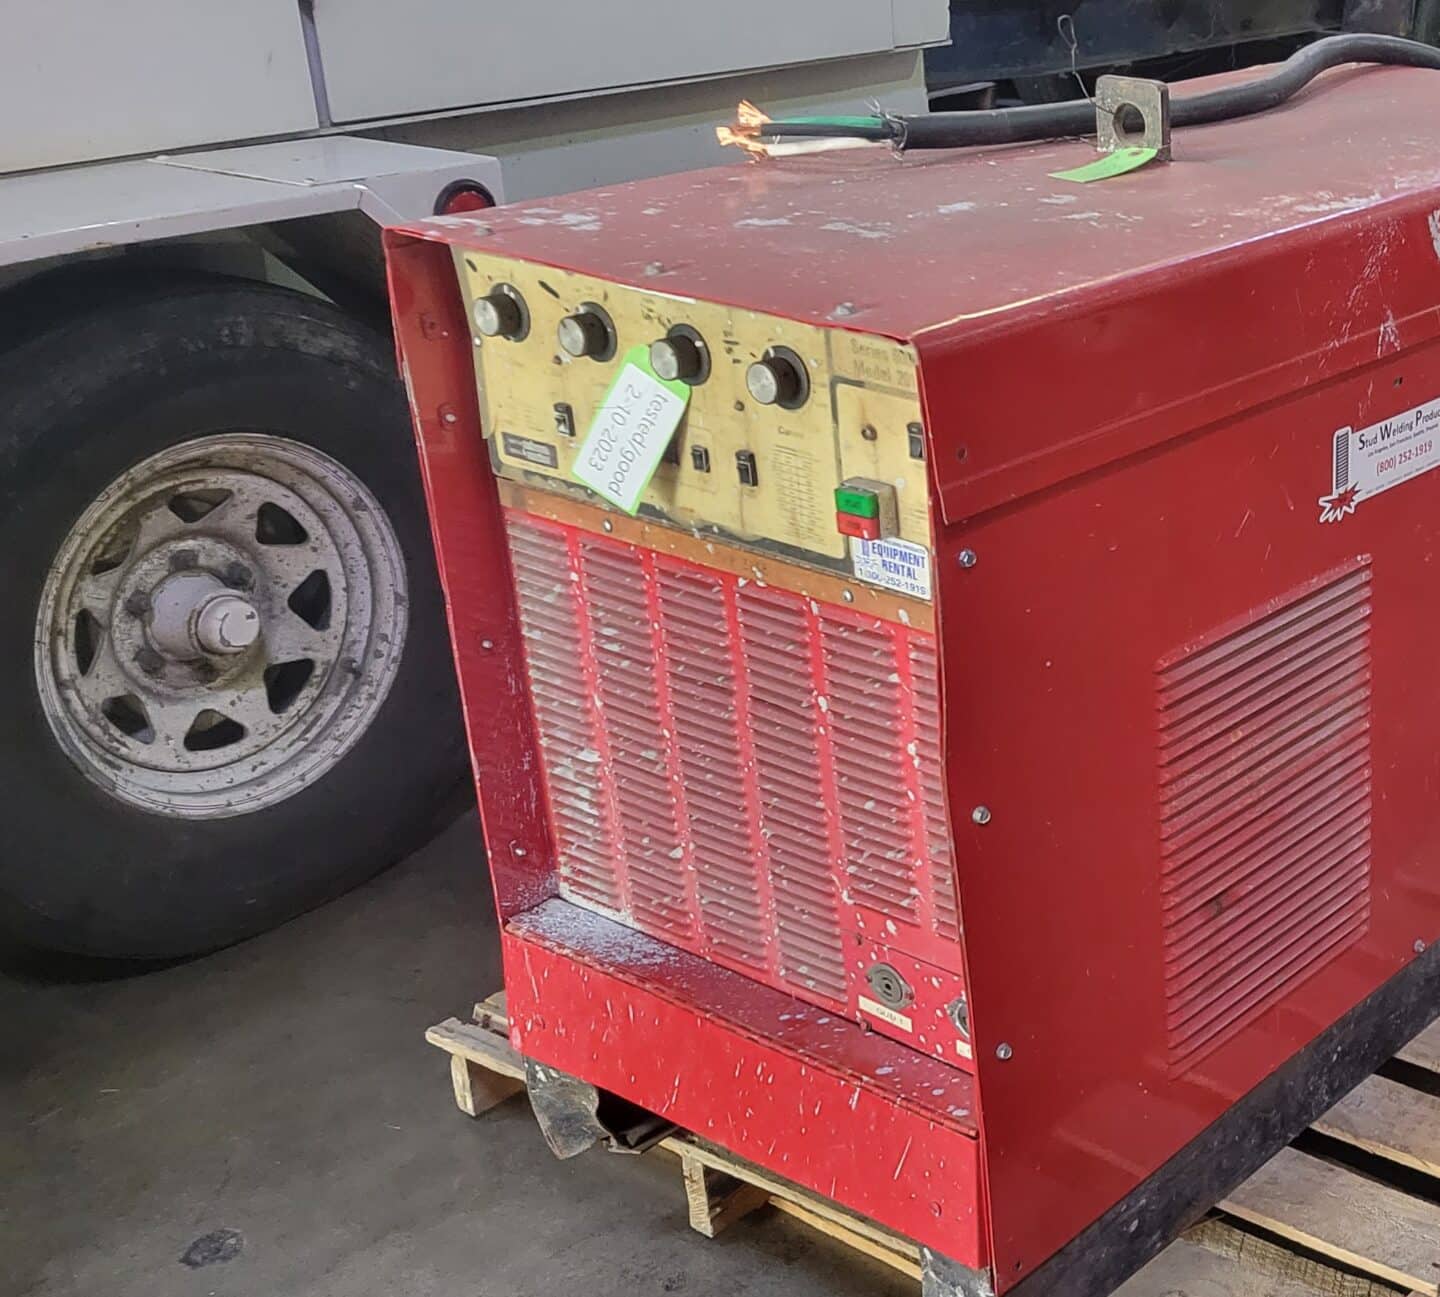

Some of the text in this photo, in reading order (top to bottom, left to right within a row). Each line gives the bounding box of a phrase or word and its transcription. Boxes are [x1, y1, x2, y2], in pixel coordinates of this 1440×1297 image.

[588, 383, 642, 472] 2-10-2023
[1358, 433, 1378, 451] Stud
[1380, 421, 1413, 442] Welding
[607, 393, 669, 497] tested/good
[1376, 455, 1397, 476] (800)
[1398, 439, 1433, 465] 252-1919
[871, 541, 926, 569] EQUIPMENT
[881, 559, 919, 581] RENTAL
